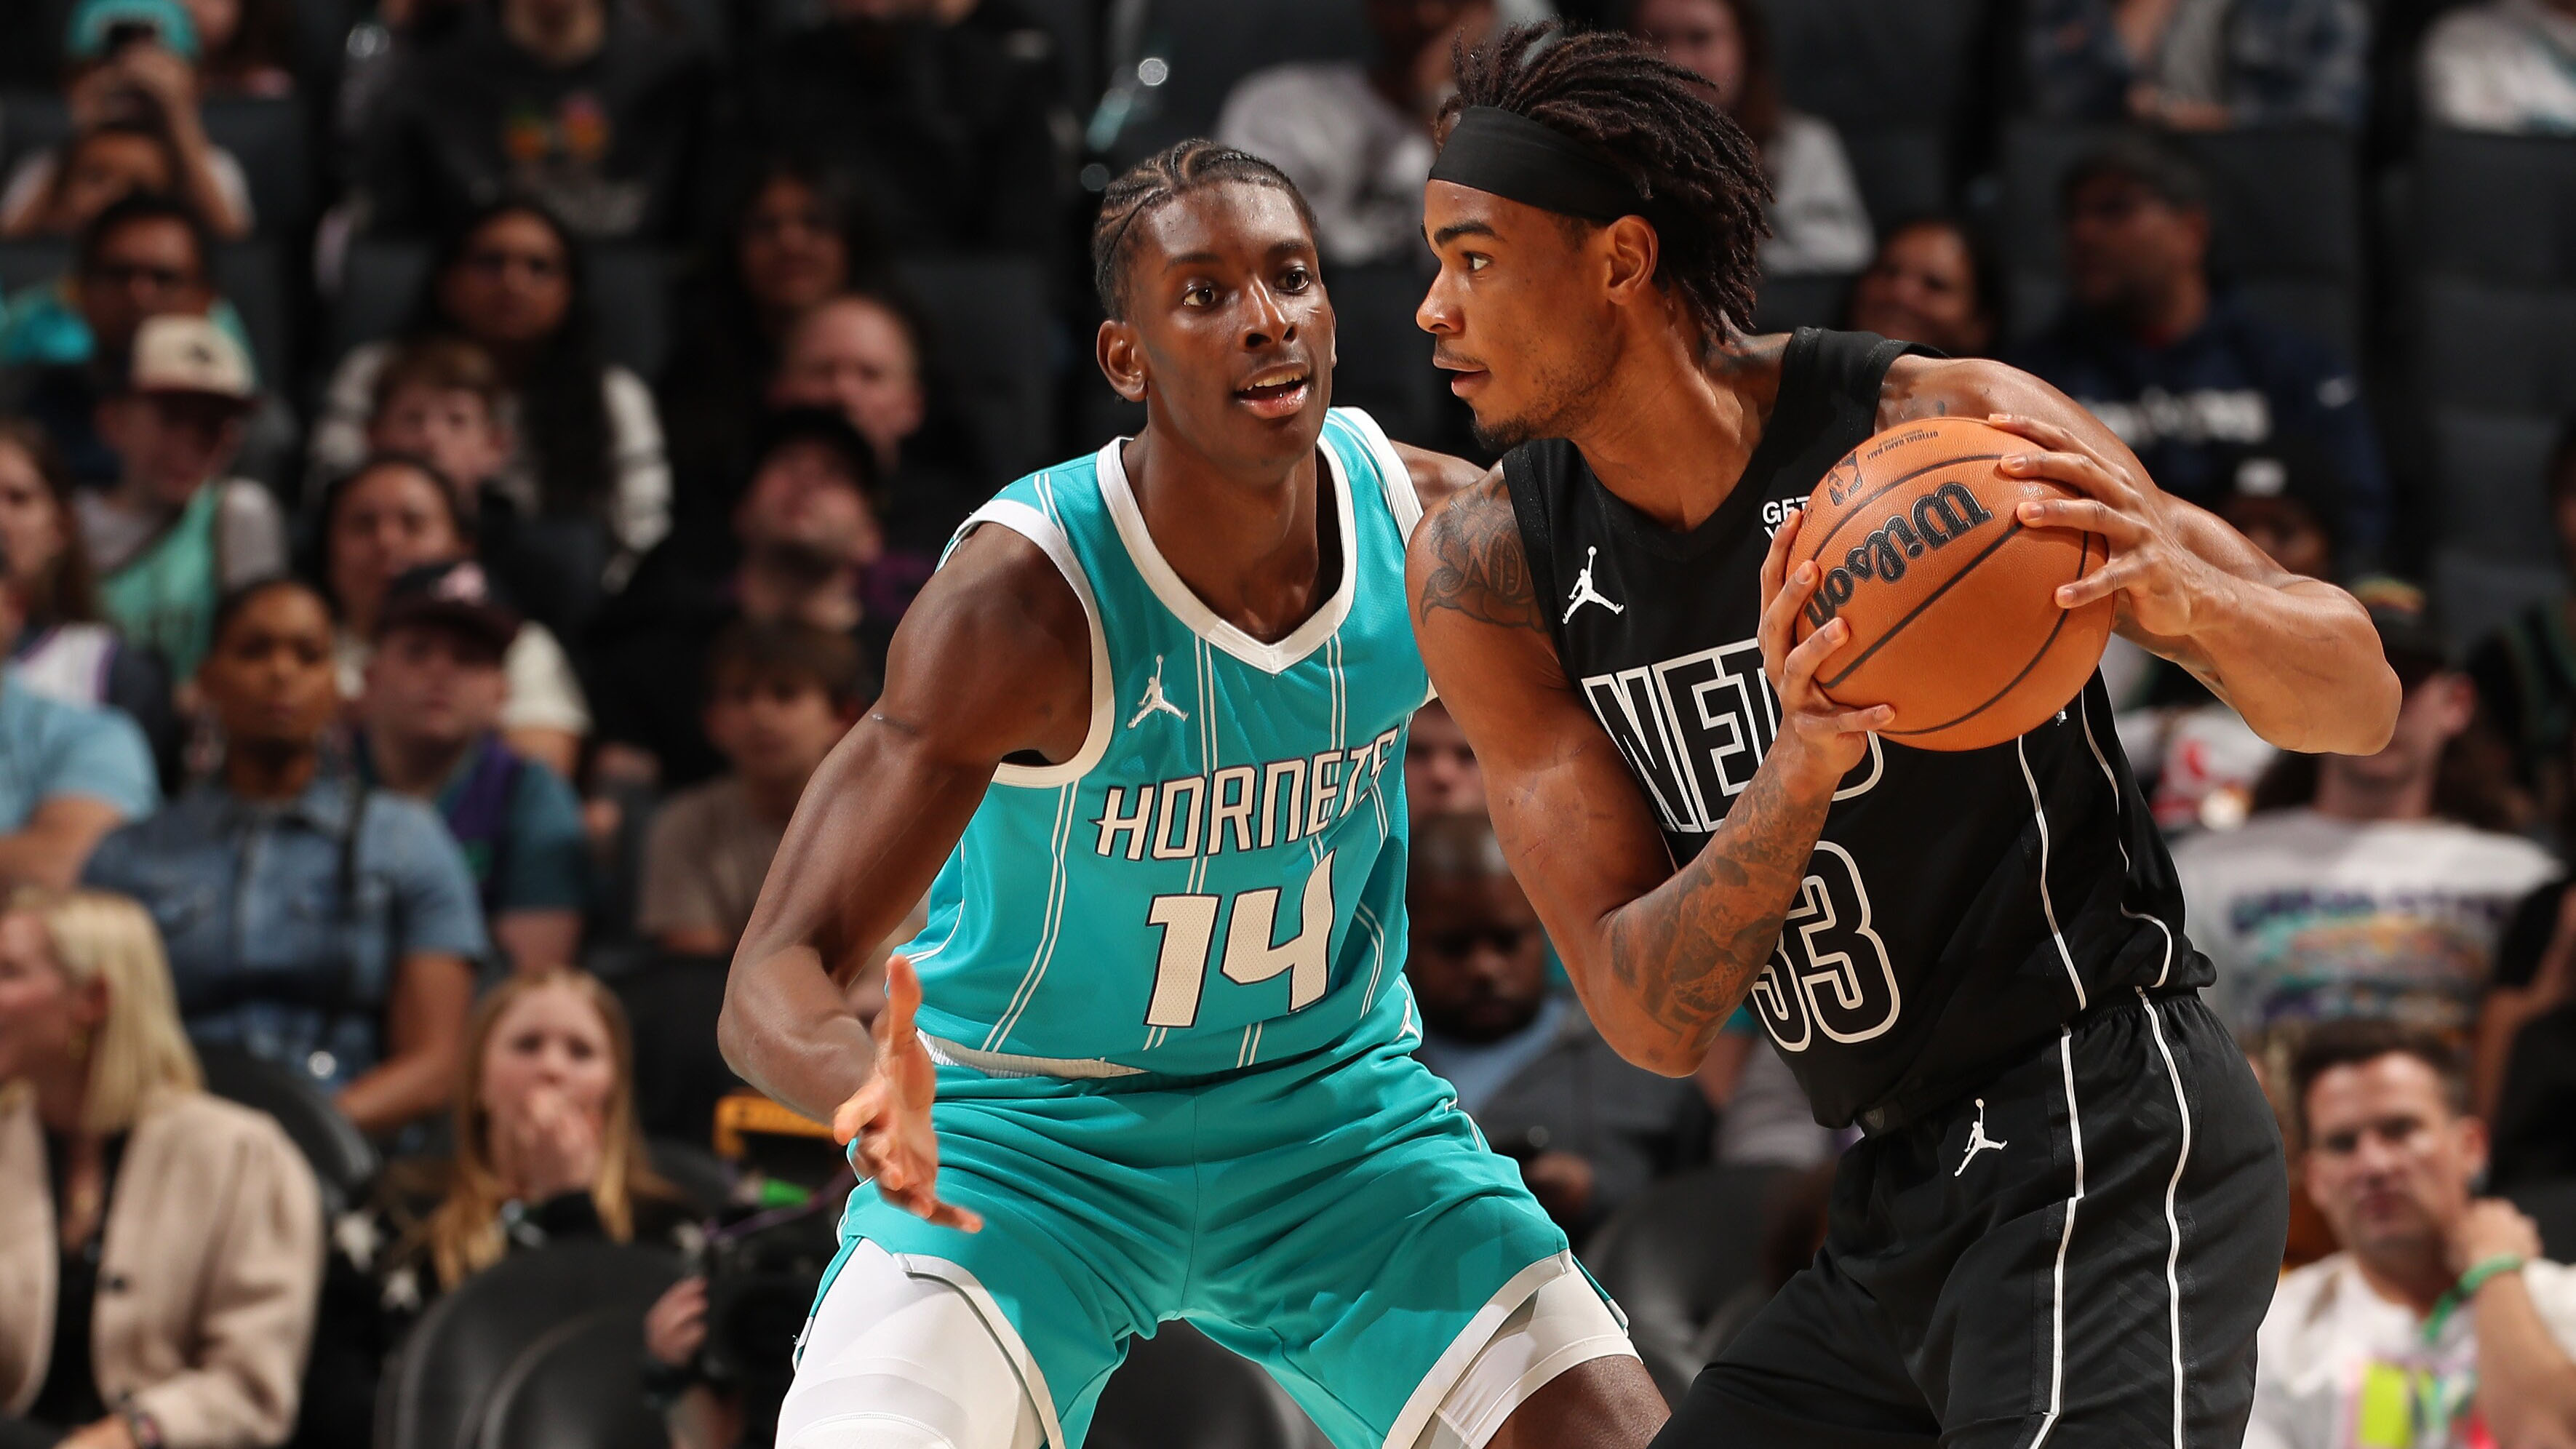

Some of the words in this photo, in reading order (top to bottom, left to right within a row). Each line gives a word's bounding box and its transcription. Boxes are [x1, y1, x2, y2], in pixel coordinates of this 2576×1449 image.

[1803, 482, 1994, 628] Wilson
[1088, 724, 1400, 861] HORNETS
[1581, 638, 1884, 834] NET
[1143, 847, 1338, 1029] 14
